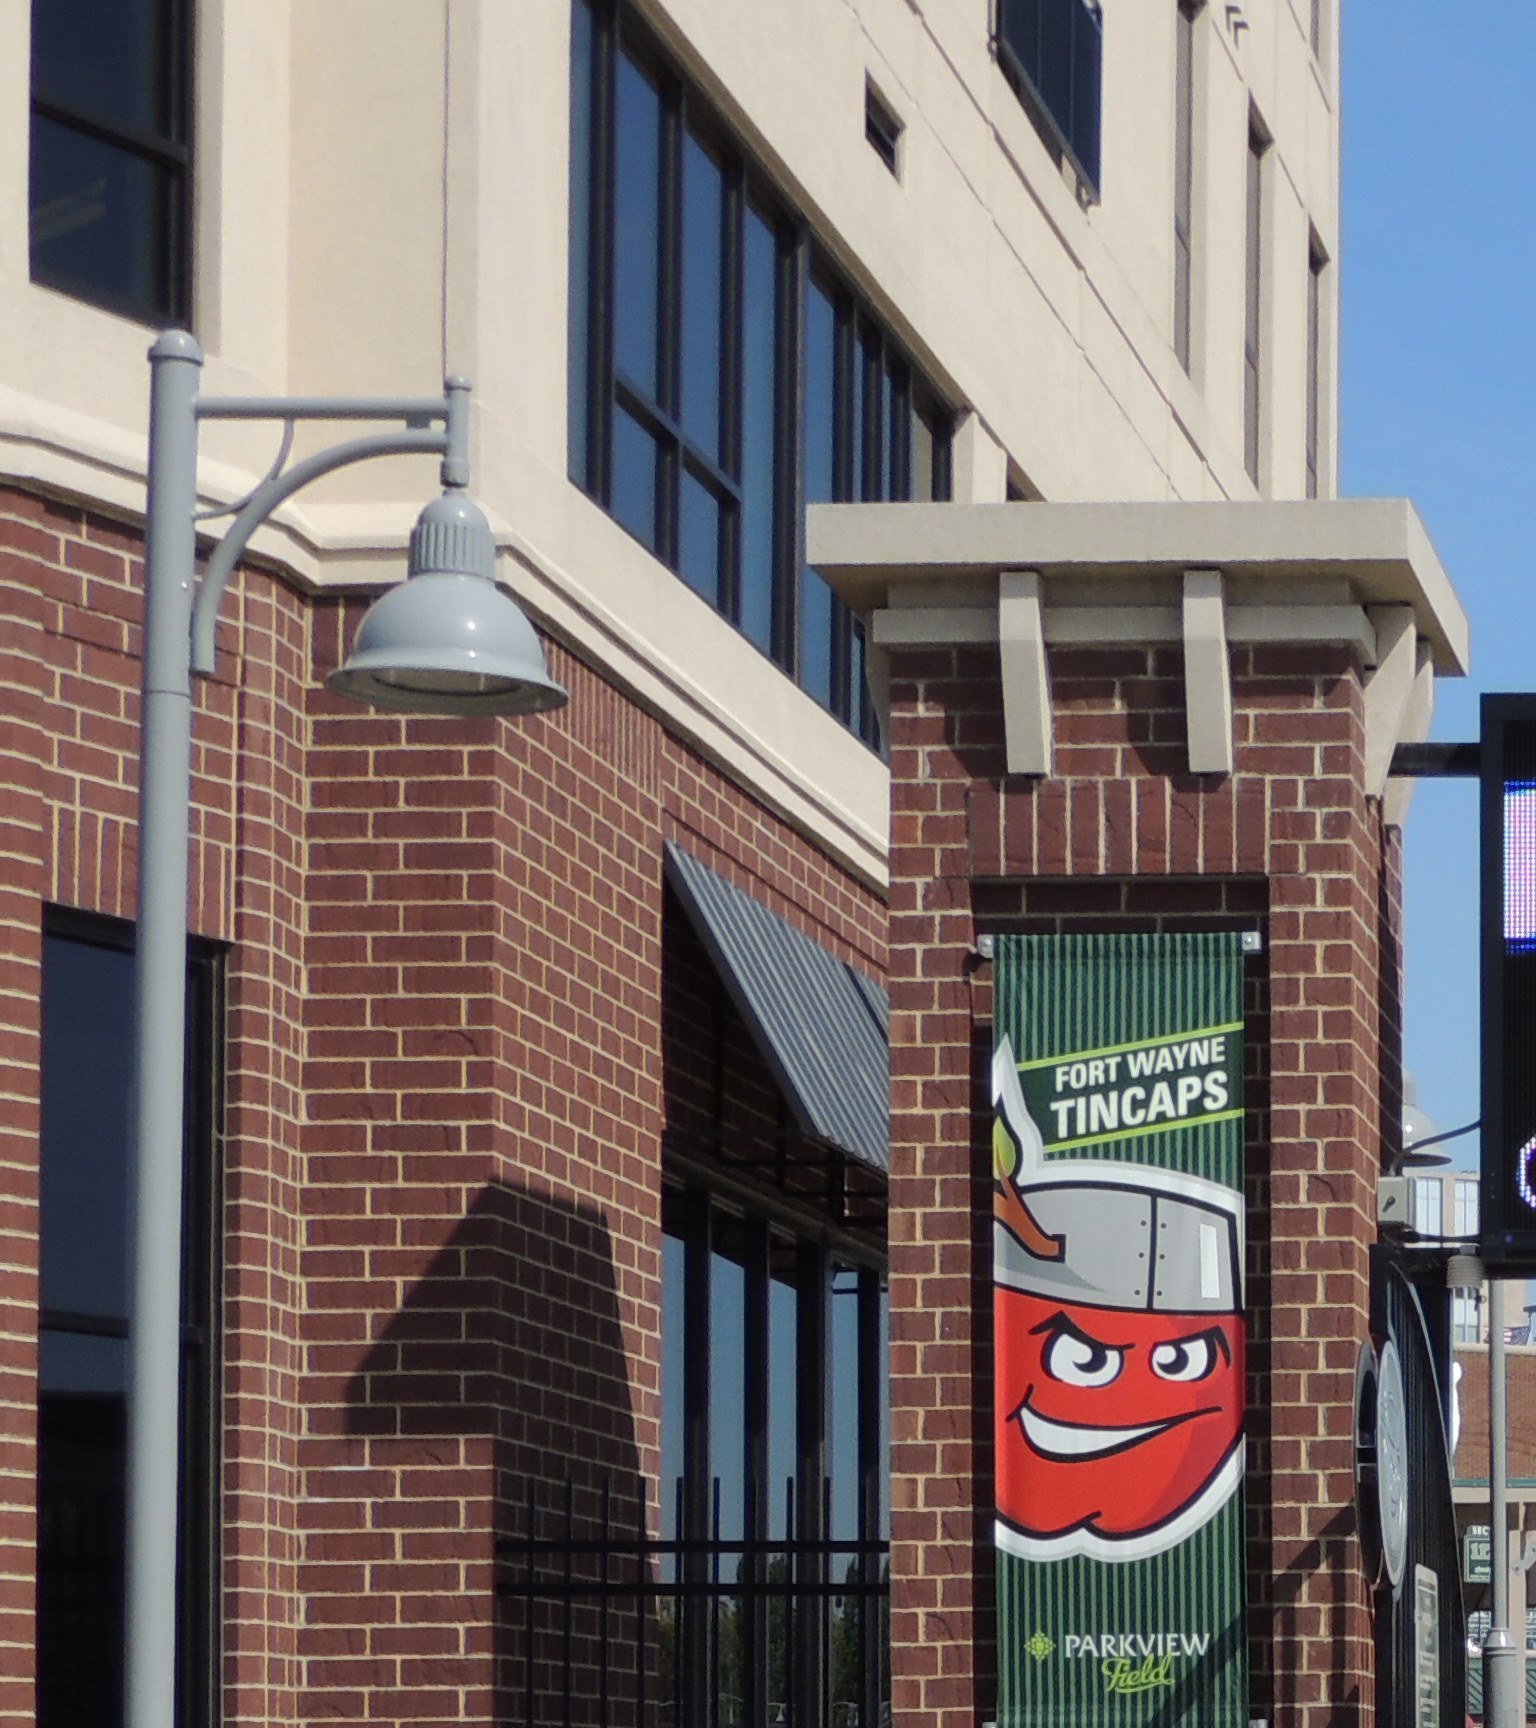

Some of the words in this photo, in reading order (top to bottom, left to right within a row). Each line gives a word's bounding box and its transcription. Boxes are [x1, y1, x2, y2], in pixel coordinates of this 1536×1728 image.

[1055, 1056, 1122, 1092] FORT
[1126, 1036, 1226, 1078] WAYNE
[1050, 1071, 1229, 1139] TINCAPS
[1064, 1633, 1211, 1658] PARKVIEW
[1101, 1652, 1175, 1694] Field
